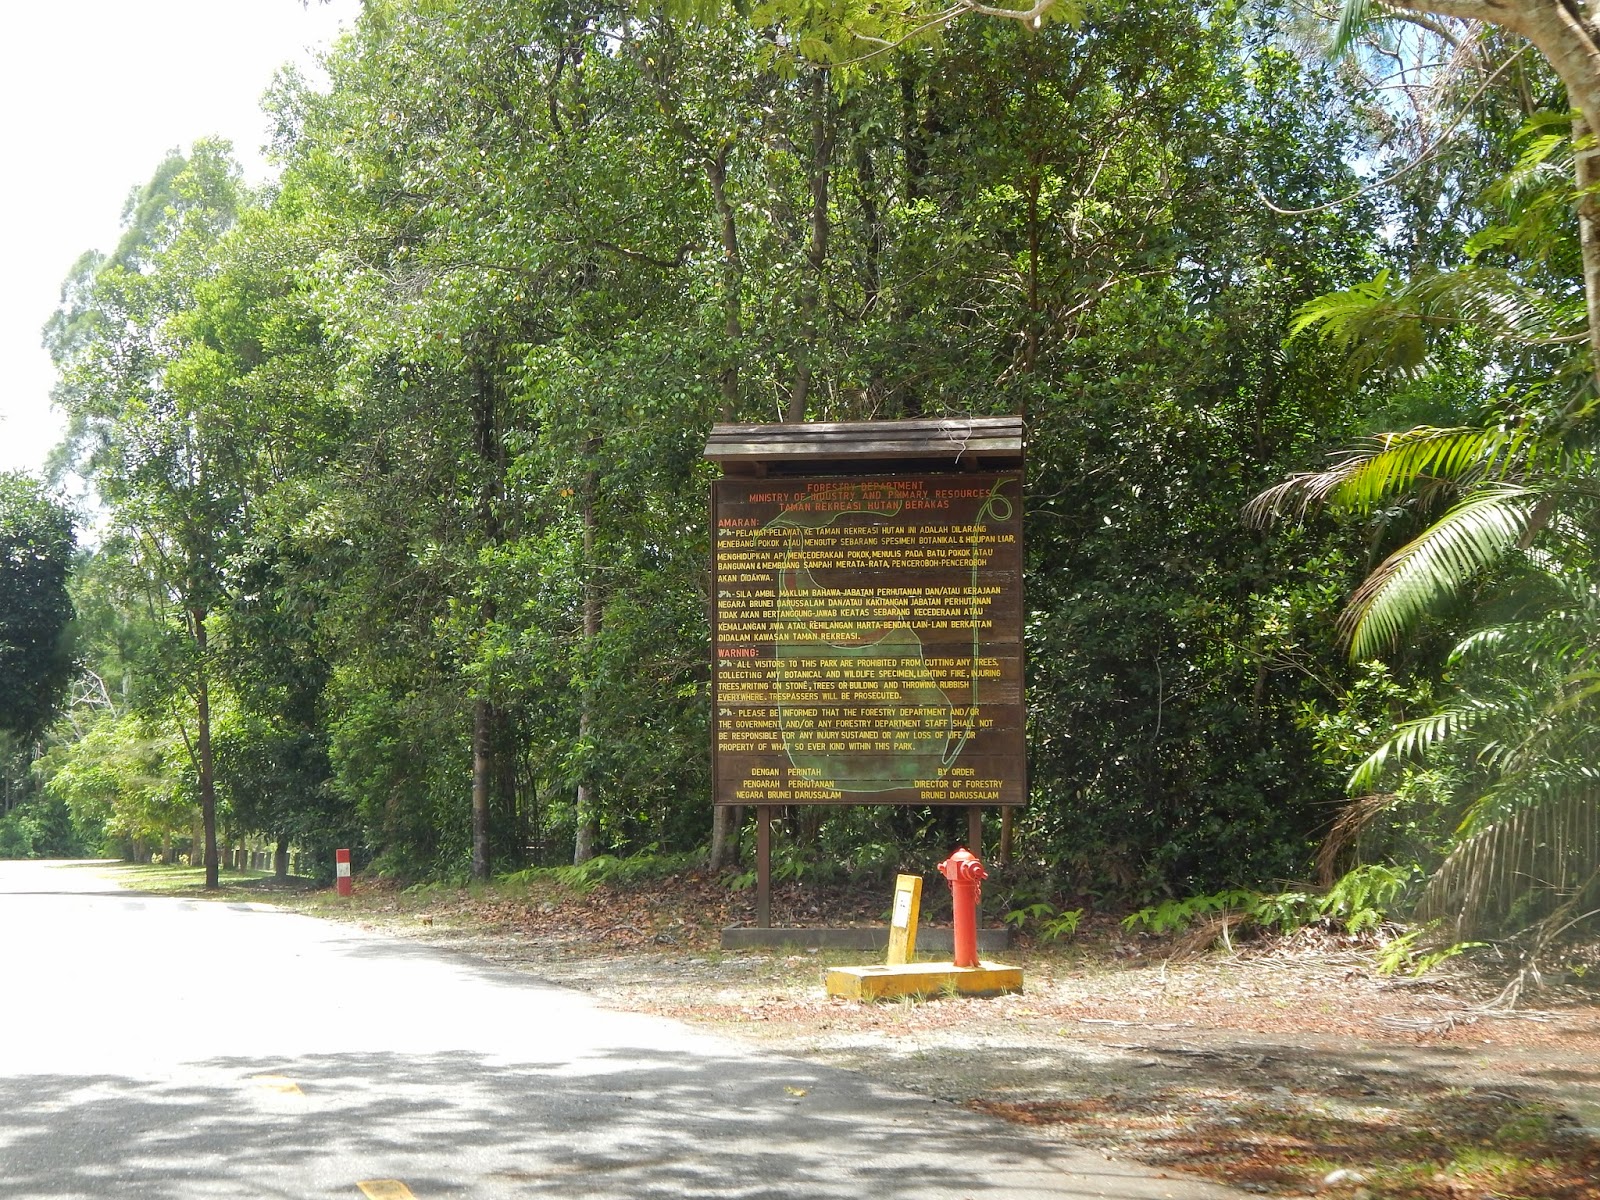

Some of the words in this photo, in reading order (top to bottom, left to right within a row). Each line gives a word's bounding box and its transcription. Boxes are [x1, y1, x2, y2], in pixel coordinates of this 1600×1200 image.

[807, 483, 855, 492] FORESTRY
[861, 482, 923, 491] DEPARTMENT
[750, 494, 789, 502] MINISTRY
[794, 493, 806, 501] OF
[811, 492, 855, 501] INDUSTRY
[863, 491, 881, 499] AND
[888, 491, 928, 499] PRIMARY
[936, 489, 991, 498] RESOURCES
[779, 503, 810, 511] TAMAN
[816, 503, 861, 511] REKREASI
[868, 501, 899, 509] HUTAN
[906, 500, 949, 509] BERAKAS
[718, 540, 753, 548] MENEBANG
[841, 537, 877, 545] SEBARANG
[882, 537, 915, 545] SPESIMEN
[804, 561, 832, 569] SAMPAH
[718, 574, 737, 582] AKAN
[741, 574, 773, 582] DIDAKWA.
[779, 589, 808, 597] MAKLUM
[925, 587, 960, 595] DAN/ATAU
[866, 598, 908, 606] KAKITANGAN
[874, 608, 910, 616] SEBARANG
[718, 623, 766, 631] KEMALANGAN
[788, 622, 806, 630] ATAU
[810, 621, 853, 629] KEHILANGAN
[951, 620, 992, 628] BERKAITAN
[754, 633, 789, 641] KAWASAN
[822, 632, 860, 640] REKREASI.
[755, 660, 785, 668] VISITORS
[951, 670, 969, 678] FIRE,
[850, 681, 878, 689] BUILDING
[884, 681, 898, 689] AND
[770, 709, 779, 717] BE
[900, 708, 946, 716] DEPARTMENT
[950, 708, 979, 716] AND/OR
[786, 720, 813, 728] AND/OR
[818, 720, 832, 728] ANY
[732, 732, 777, 740] RESPONSIBLE
[967, 731, 975, 739] OR
[719, 743, 753, 751] PROPERTY
[752, 768, 779, 776] DENGAN
[788, 768, 822, 776] PERINTAH
[938, 768, 948, 776] BY
[952, 768, 974, 776] ORDER
[743, 780, 780, 788] PENGARAH
[788, 780, 834, 788] PERHUTANAN
[914, 780, 948, 788] DIRECTOR
[953, 780, 961, 788] OF
[965, 780, 1002, 788] FORESTRY
[736, 791, 763, 799] NEGARA
[768, 791, 791, 799] BRUNEI
[795, 791, 841, 799] DARUSSALAM
[921, 791, 946, 799] BRUNEI
[950, 791, 998, 799] DARUSSALAM
